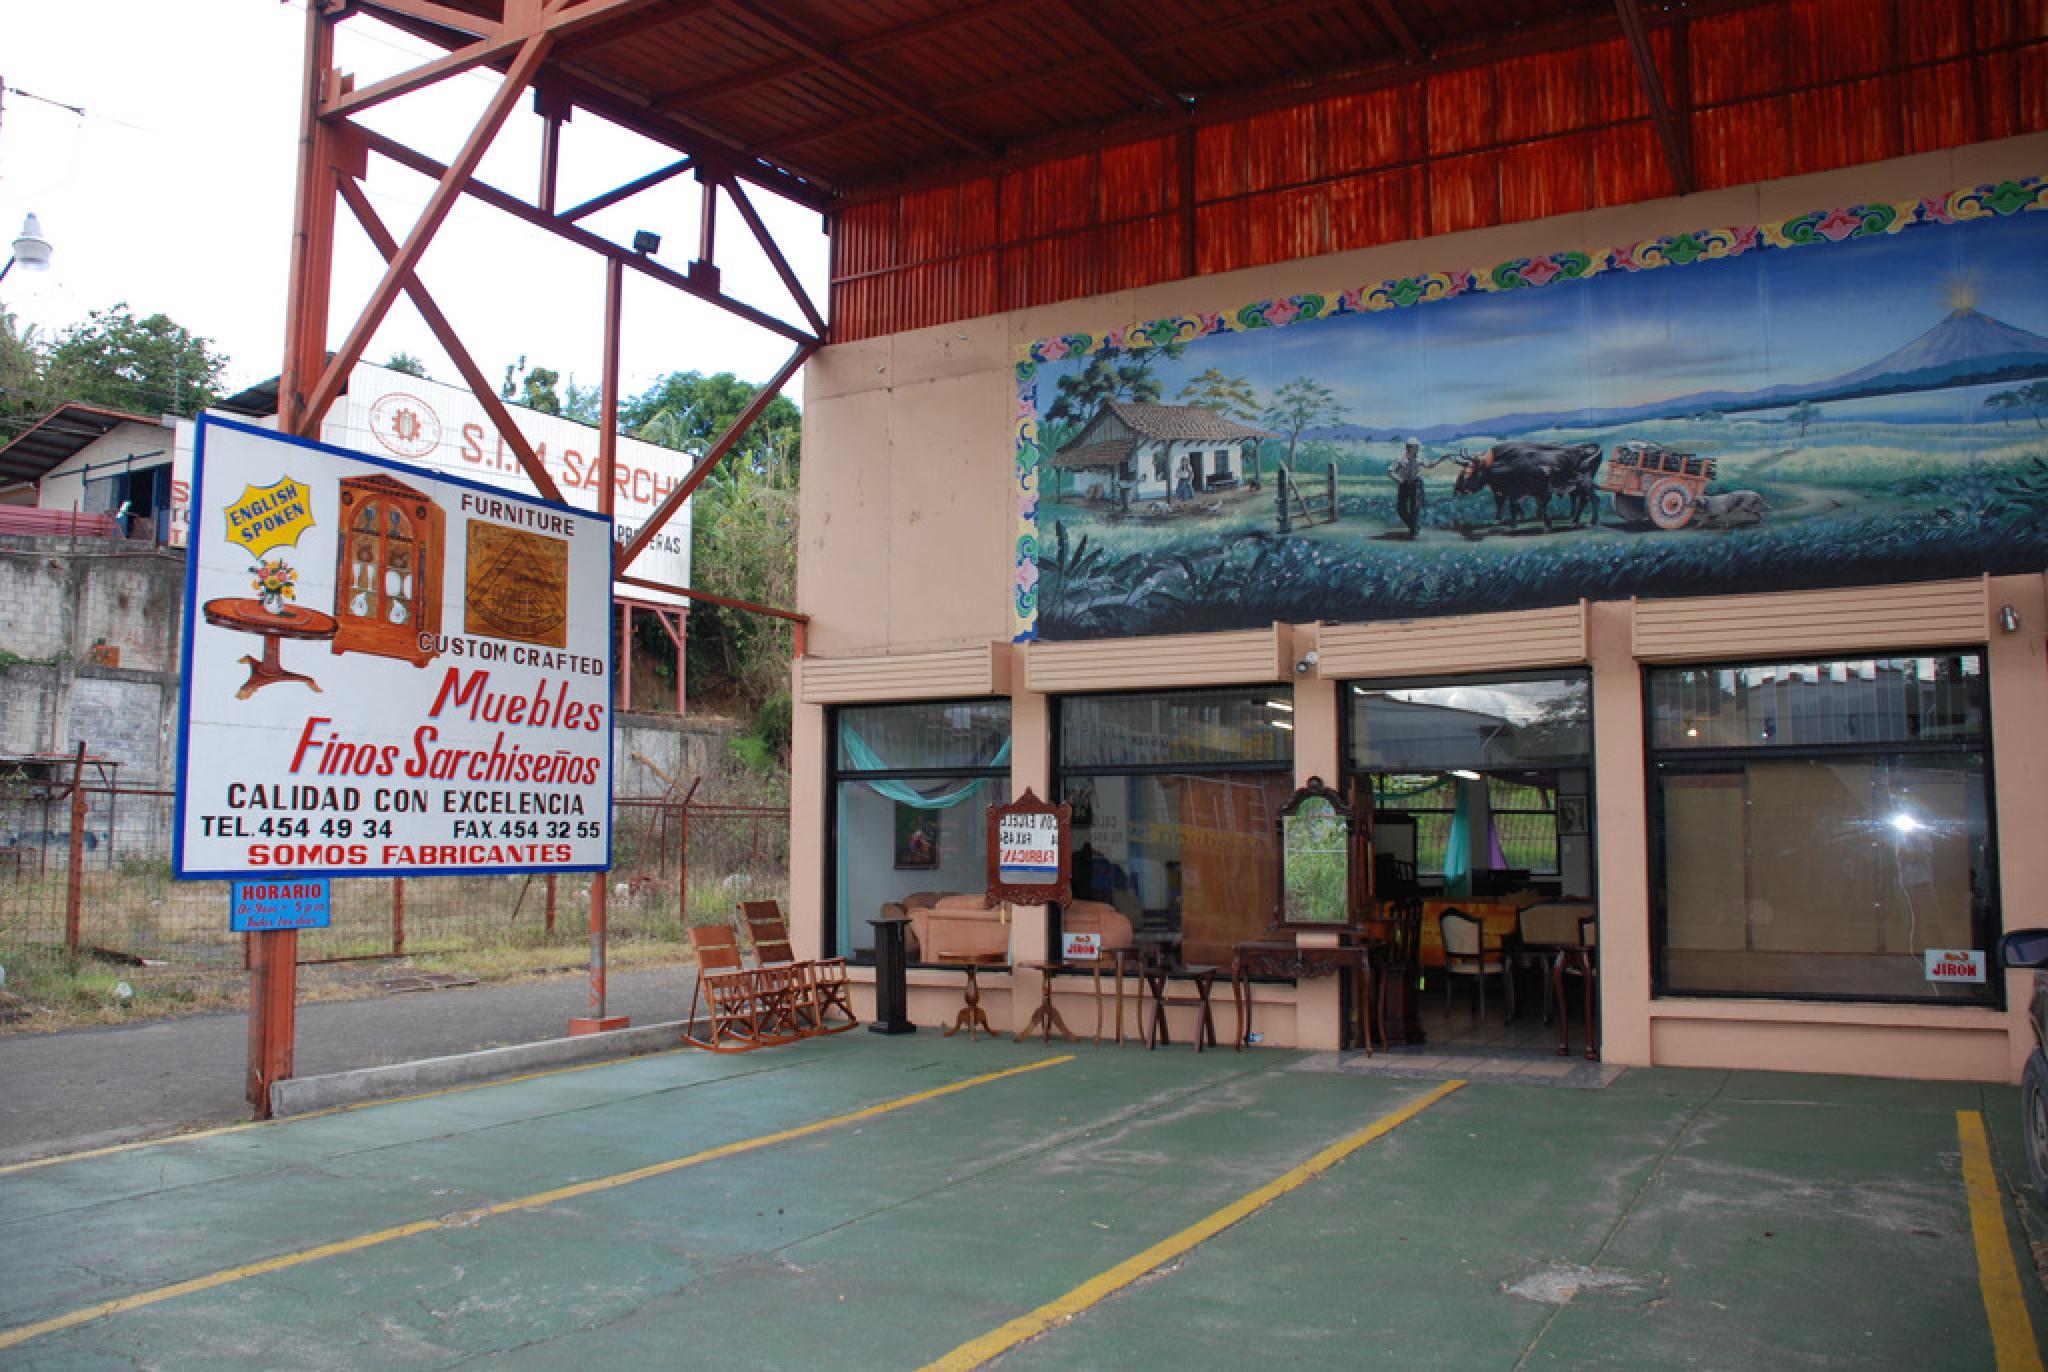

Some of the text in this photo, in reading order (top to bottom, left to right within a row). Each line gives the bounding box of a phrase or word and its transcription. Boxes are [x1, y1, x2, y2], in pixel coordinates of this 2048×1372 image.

[229, 483, 298, 527] ENGLISH
[241, 501, 305, 543] SPOKEN
[461, 493, 575, 537] FURNITURE
[418, 633, 605, 676] CUSTOM CRAFTED
[427, 665, 605, 732] Muebles
[289, 716, 601, 785] Finos Sarchiseños
[227, 781, 585, 815] CALIDAD CON EXCELENCIA
[320, 817, 353, 839] 49
[362, 818, 393, 839] 34
[546, 820, 571, 839] 32
[577, 820, 601, 839] 55
[247, 843, 572, 865] SOMOS FABRICANTES
[242, 883, 322, 900] HORARIO
